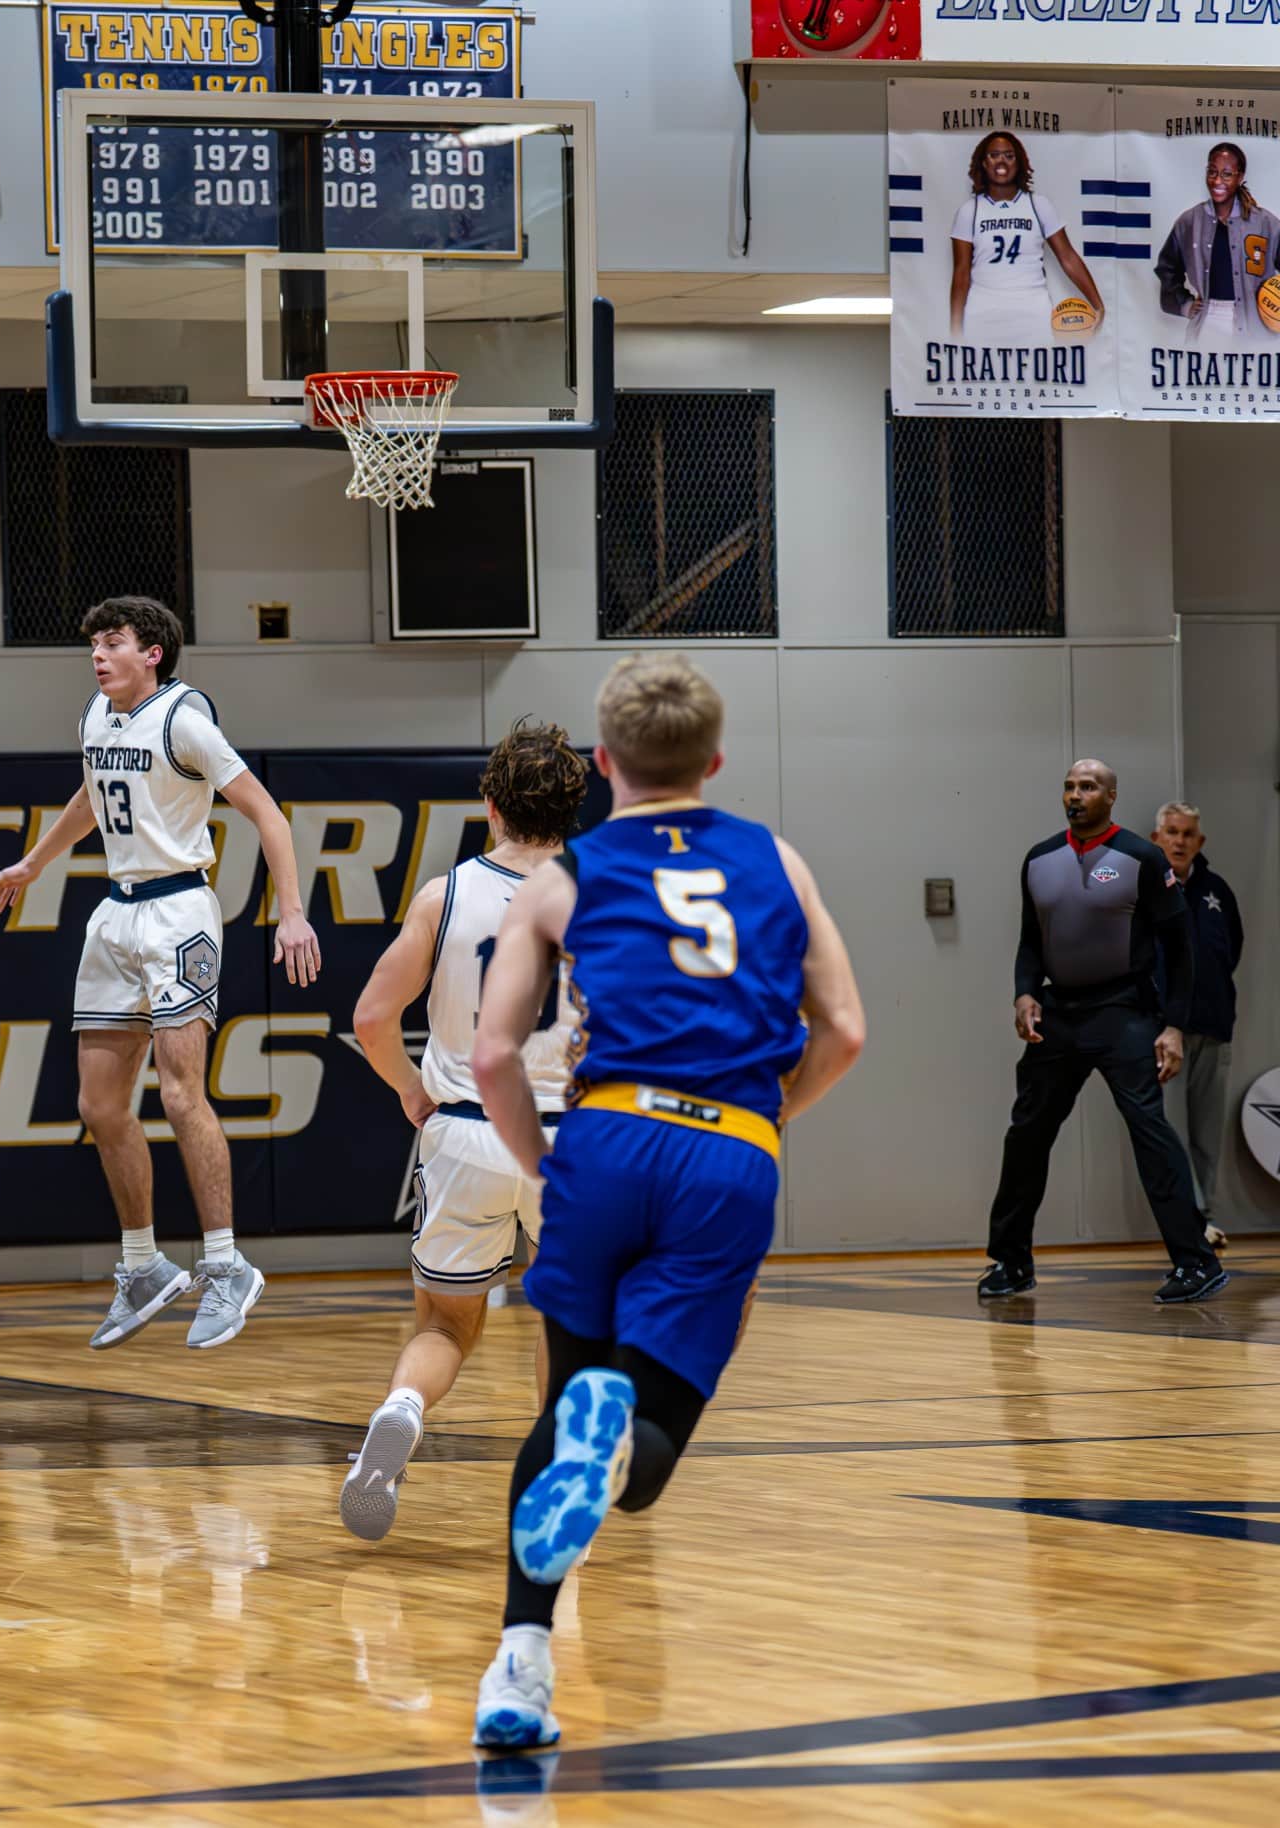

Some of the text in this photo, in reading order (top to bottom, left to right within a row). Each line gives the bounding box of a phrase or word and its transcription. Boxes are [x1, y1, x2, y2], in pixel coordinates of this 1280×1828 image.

[56, 10, 509, 73] TENNIS INGLES
[81, 73, 481, 97] 1969 1970 71 1972
[970, 89, 1031, 101] SENIOR
[1196, 98, 1256, 109] SENIOR
[942, 107, 1061, 133] KALIYA WALKER
[1165, 115, 1229, 138] SHAMIYA
[93, 143, 483, 175] 978 1979 89 1990
[93, 178, 484, 209] 991 2001 002 2003
[93, 212, 162, 238] 2005
[979, 218, 1033, 233] STRATFORD
[989, 235, 1022, 264] 34
[926, 342, 1086, 386] STRATFORD
[937, 387, 1075, 398] BASKETBALL
[977, 401, 1034, 411] 2024
[1202, 406, 1258, 415] 2024
[97, 780, 134, 835] 13
[653, 825, 692, 854] T
[653, 867, 738, 979] 5
